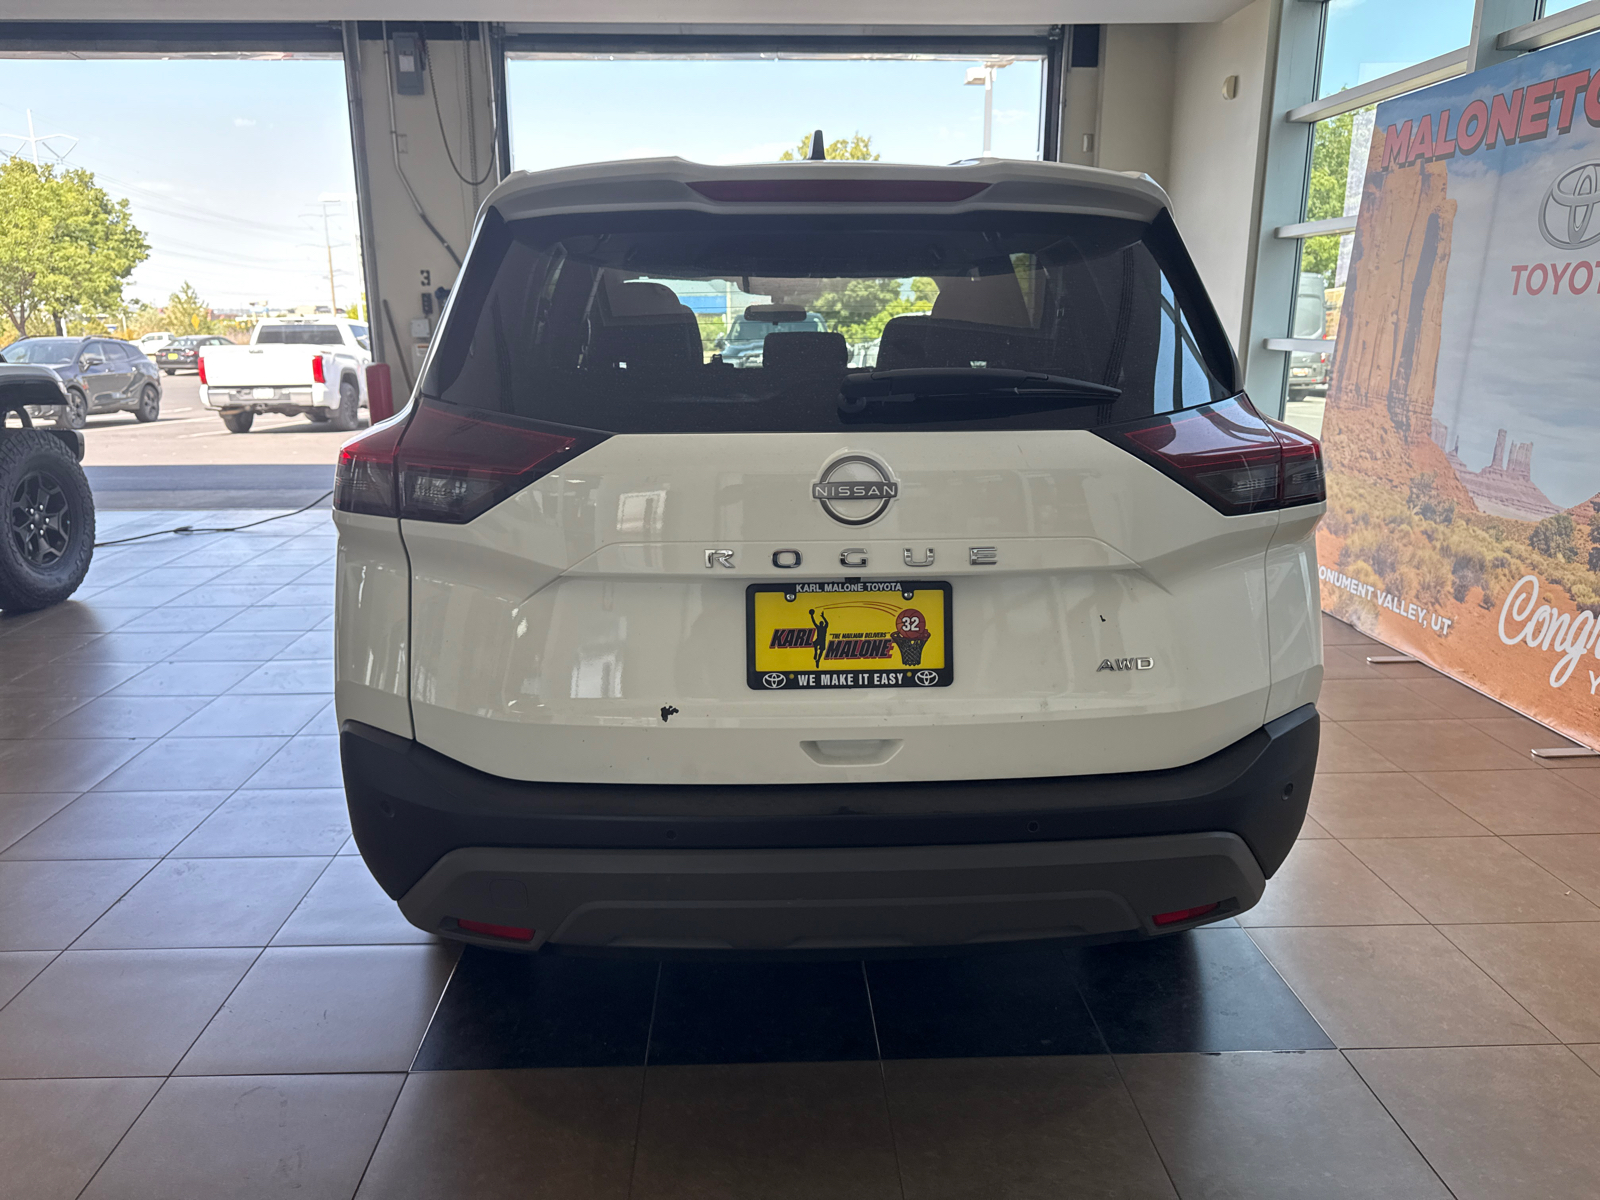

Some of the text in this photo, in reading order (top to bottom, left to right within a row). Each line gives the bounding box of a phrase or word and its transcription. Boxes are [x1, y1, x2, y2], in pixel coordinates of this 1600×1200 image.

[420, 270, 431, 286] 3
[815, 485, 897, 497] NISSAN
[704, 546, 998, 569] ROGUE
[796, 582, 902, 593] KARL MALONE TOYOTA
[1317, 564, 1452, 635] ONUMENT VALLEY, UT
[901, 617, 920, 631] 32
[769, 628, 816, 649] KARL
[824, 639, 893, 660] MALONE
[1096, 658, 1154, 672] AWD
[798, 672, 903, 686] WE MAKE IT EASY
